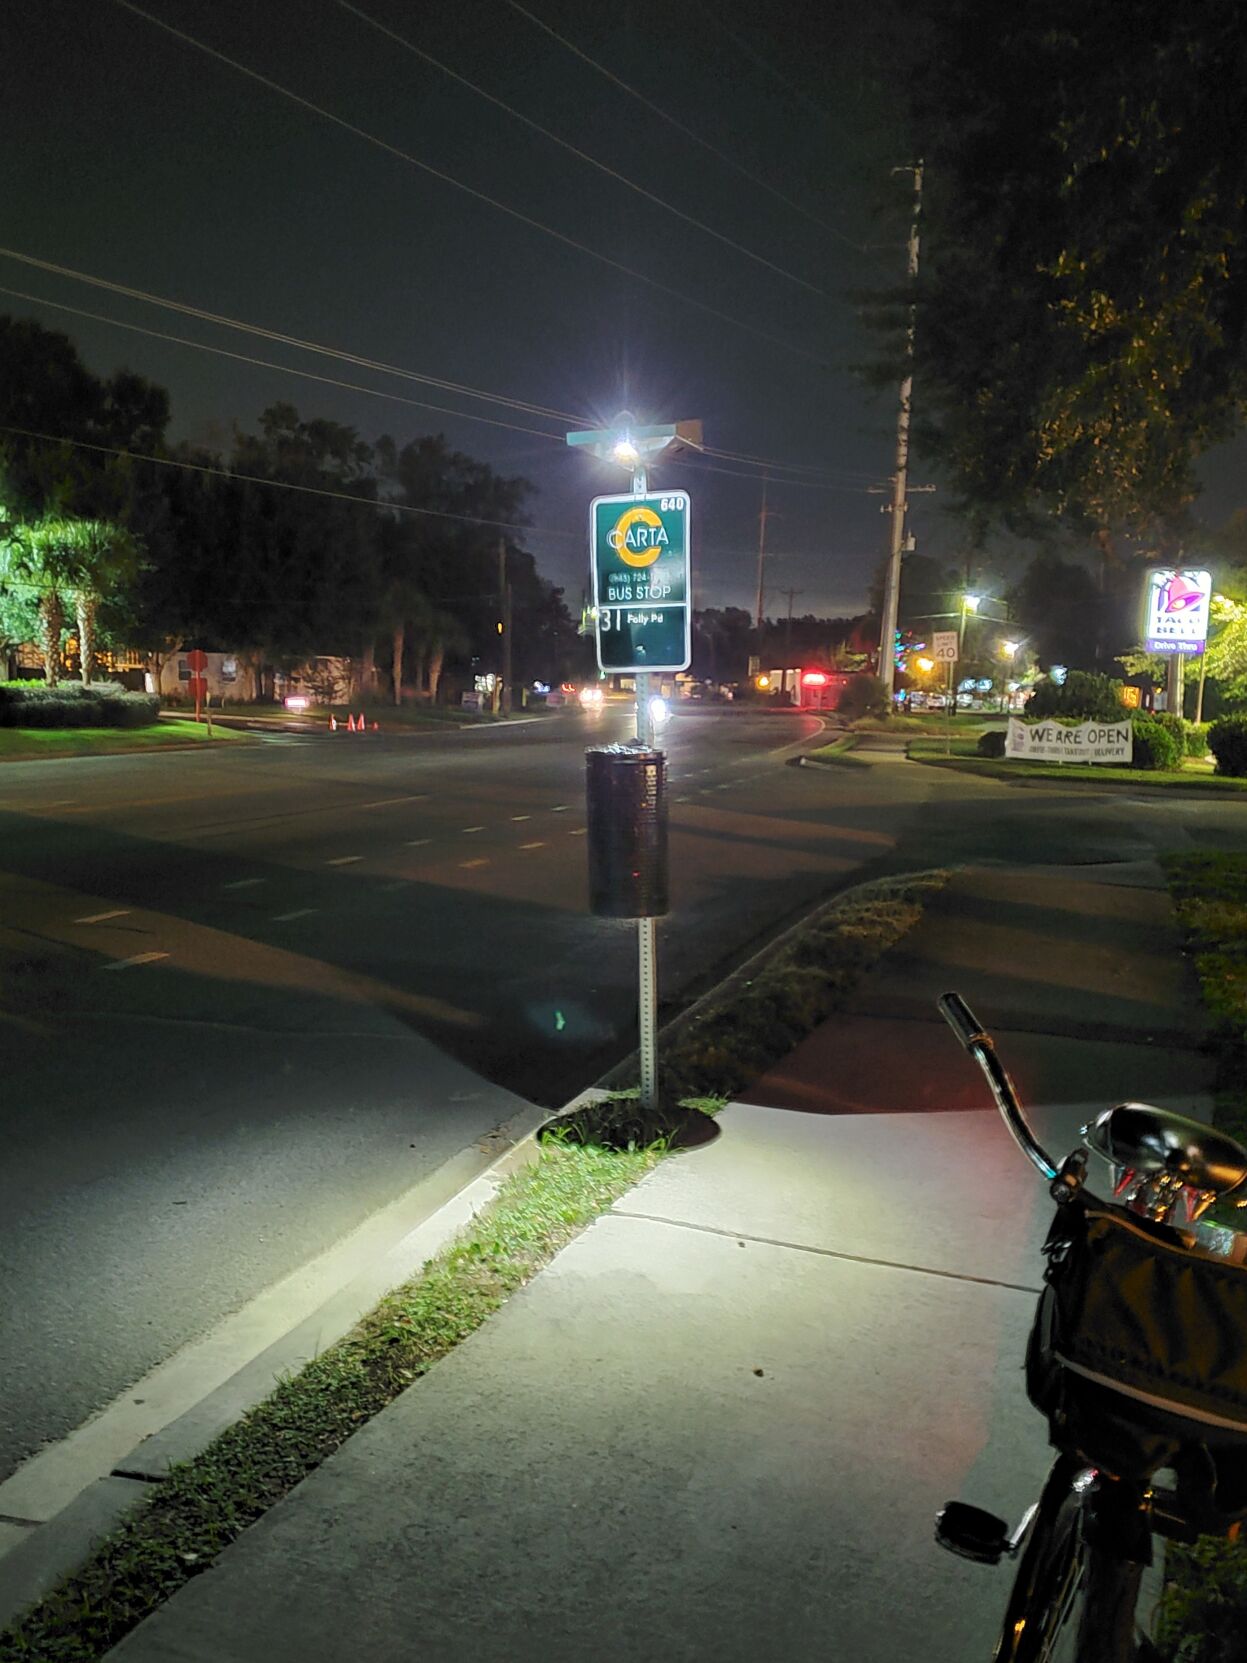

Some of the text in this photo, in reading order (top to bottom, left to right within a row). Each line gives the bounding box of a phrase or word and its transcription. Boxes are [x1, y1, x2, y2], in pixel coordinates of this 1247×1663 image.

[661, 497, 684, 511] 640
[607, 527, 669, 549] CARTA
[608, 585, 671, 601] BUS STOP
[601, 609, 621, 632] 31
[627, 613, 649, 626] Folly
[936, 647, 956, 658] 40
[1154, 641, 1177, 650] Drive
[1029, 728, 1129, 744] WE ARE OPEN
